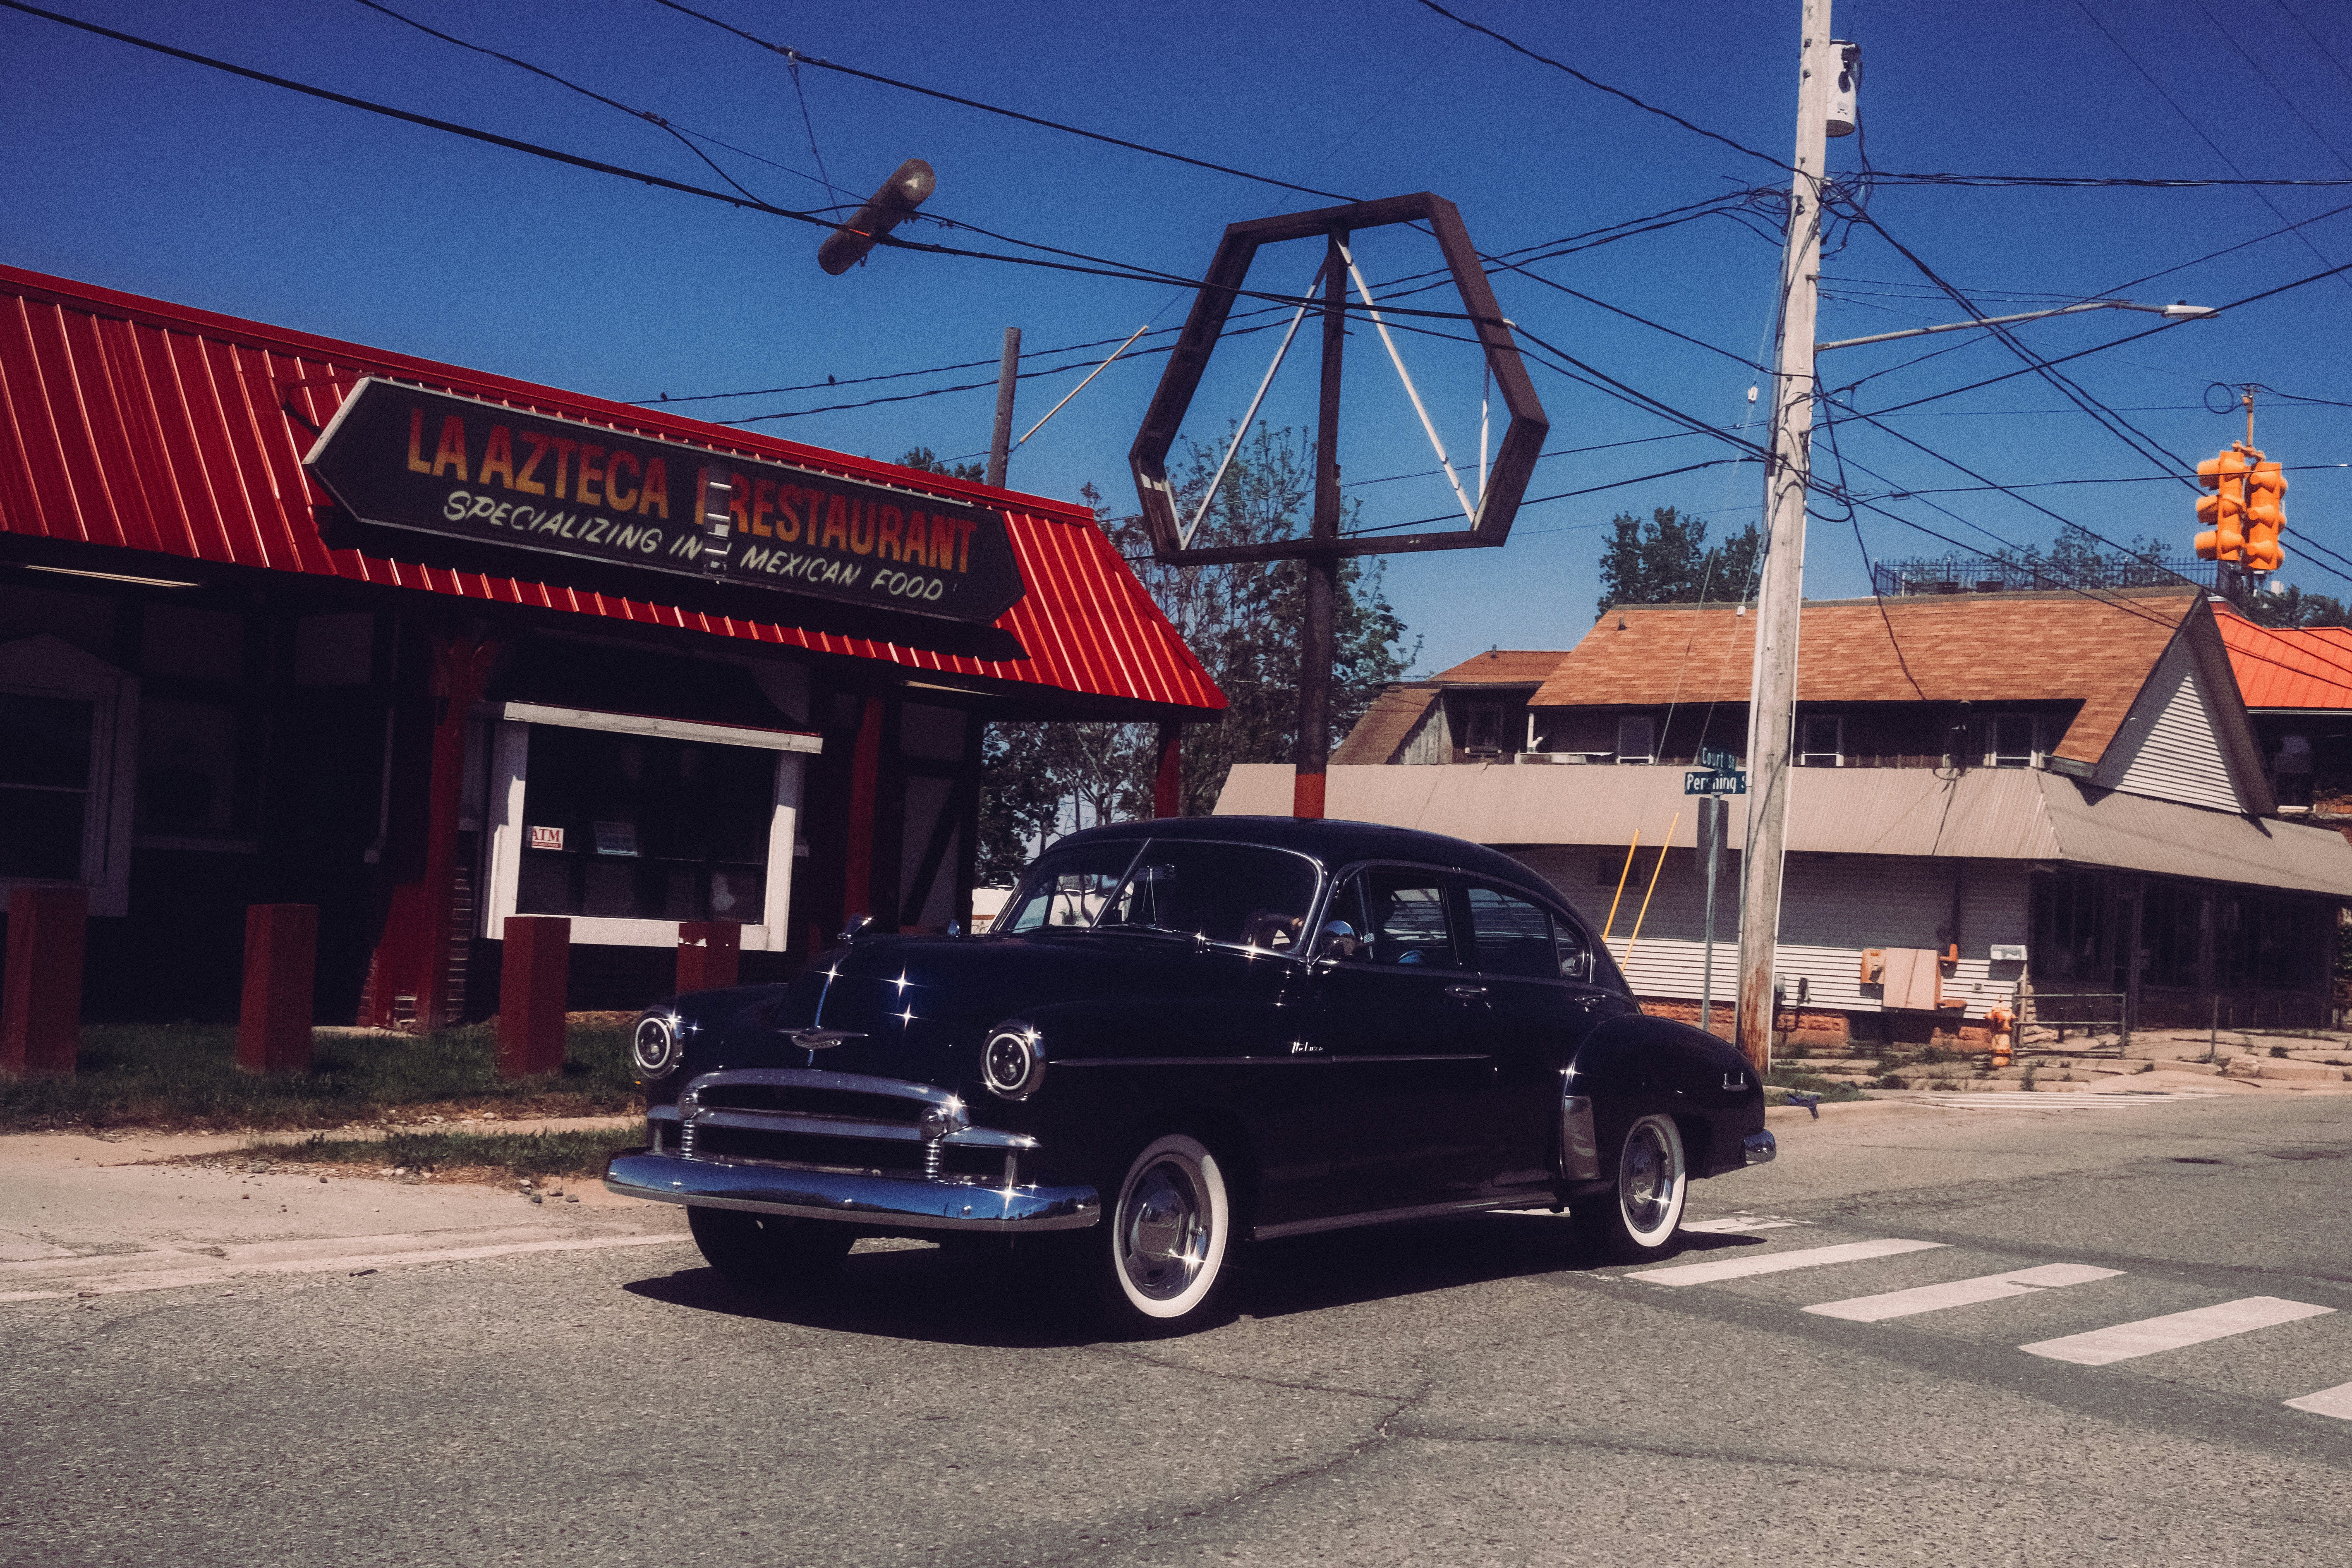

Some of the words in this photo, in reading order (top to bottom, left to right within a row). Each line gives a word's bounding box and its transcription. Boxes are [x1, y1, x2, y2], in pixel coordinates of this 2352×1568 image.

[407, 408, 468, 482] LA
[479, 424, 669, 519] AZTECA
[695, 467, 978, 573] RESTAURANT
[443, 490, 663, 554] SPECIALIZING
[669, 534, 704, 561] IN
[740, 545, 862, 587] MEXICAN
[870, 568, 944, 601] FOOD
[1702, 747, 1724, 768] Court
[1686, 773, 1737, 794] Perhing
[532, 828, 560, 842] ATM
